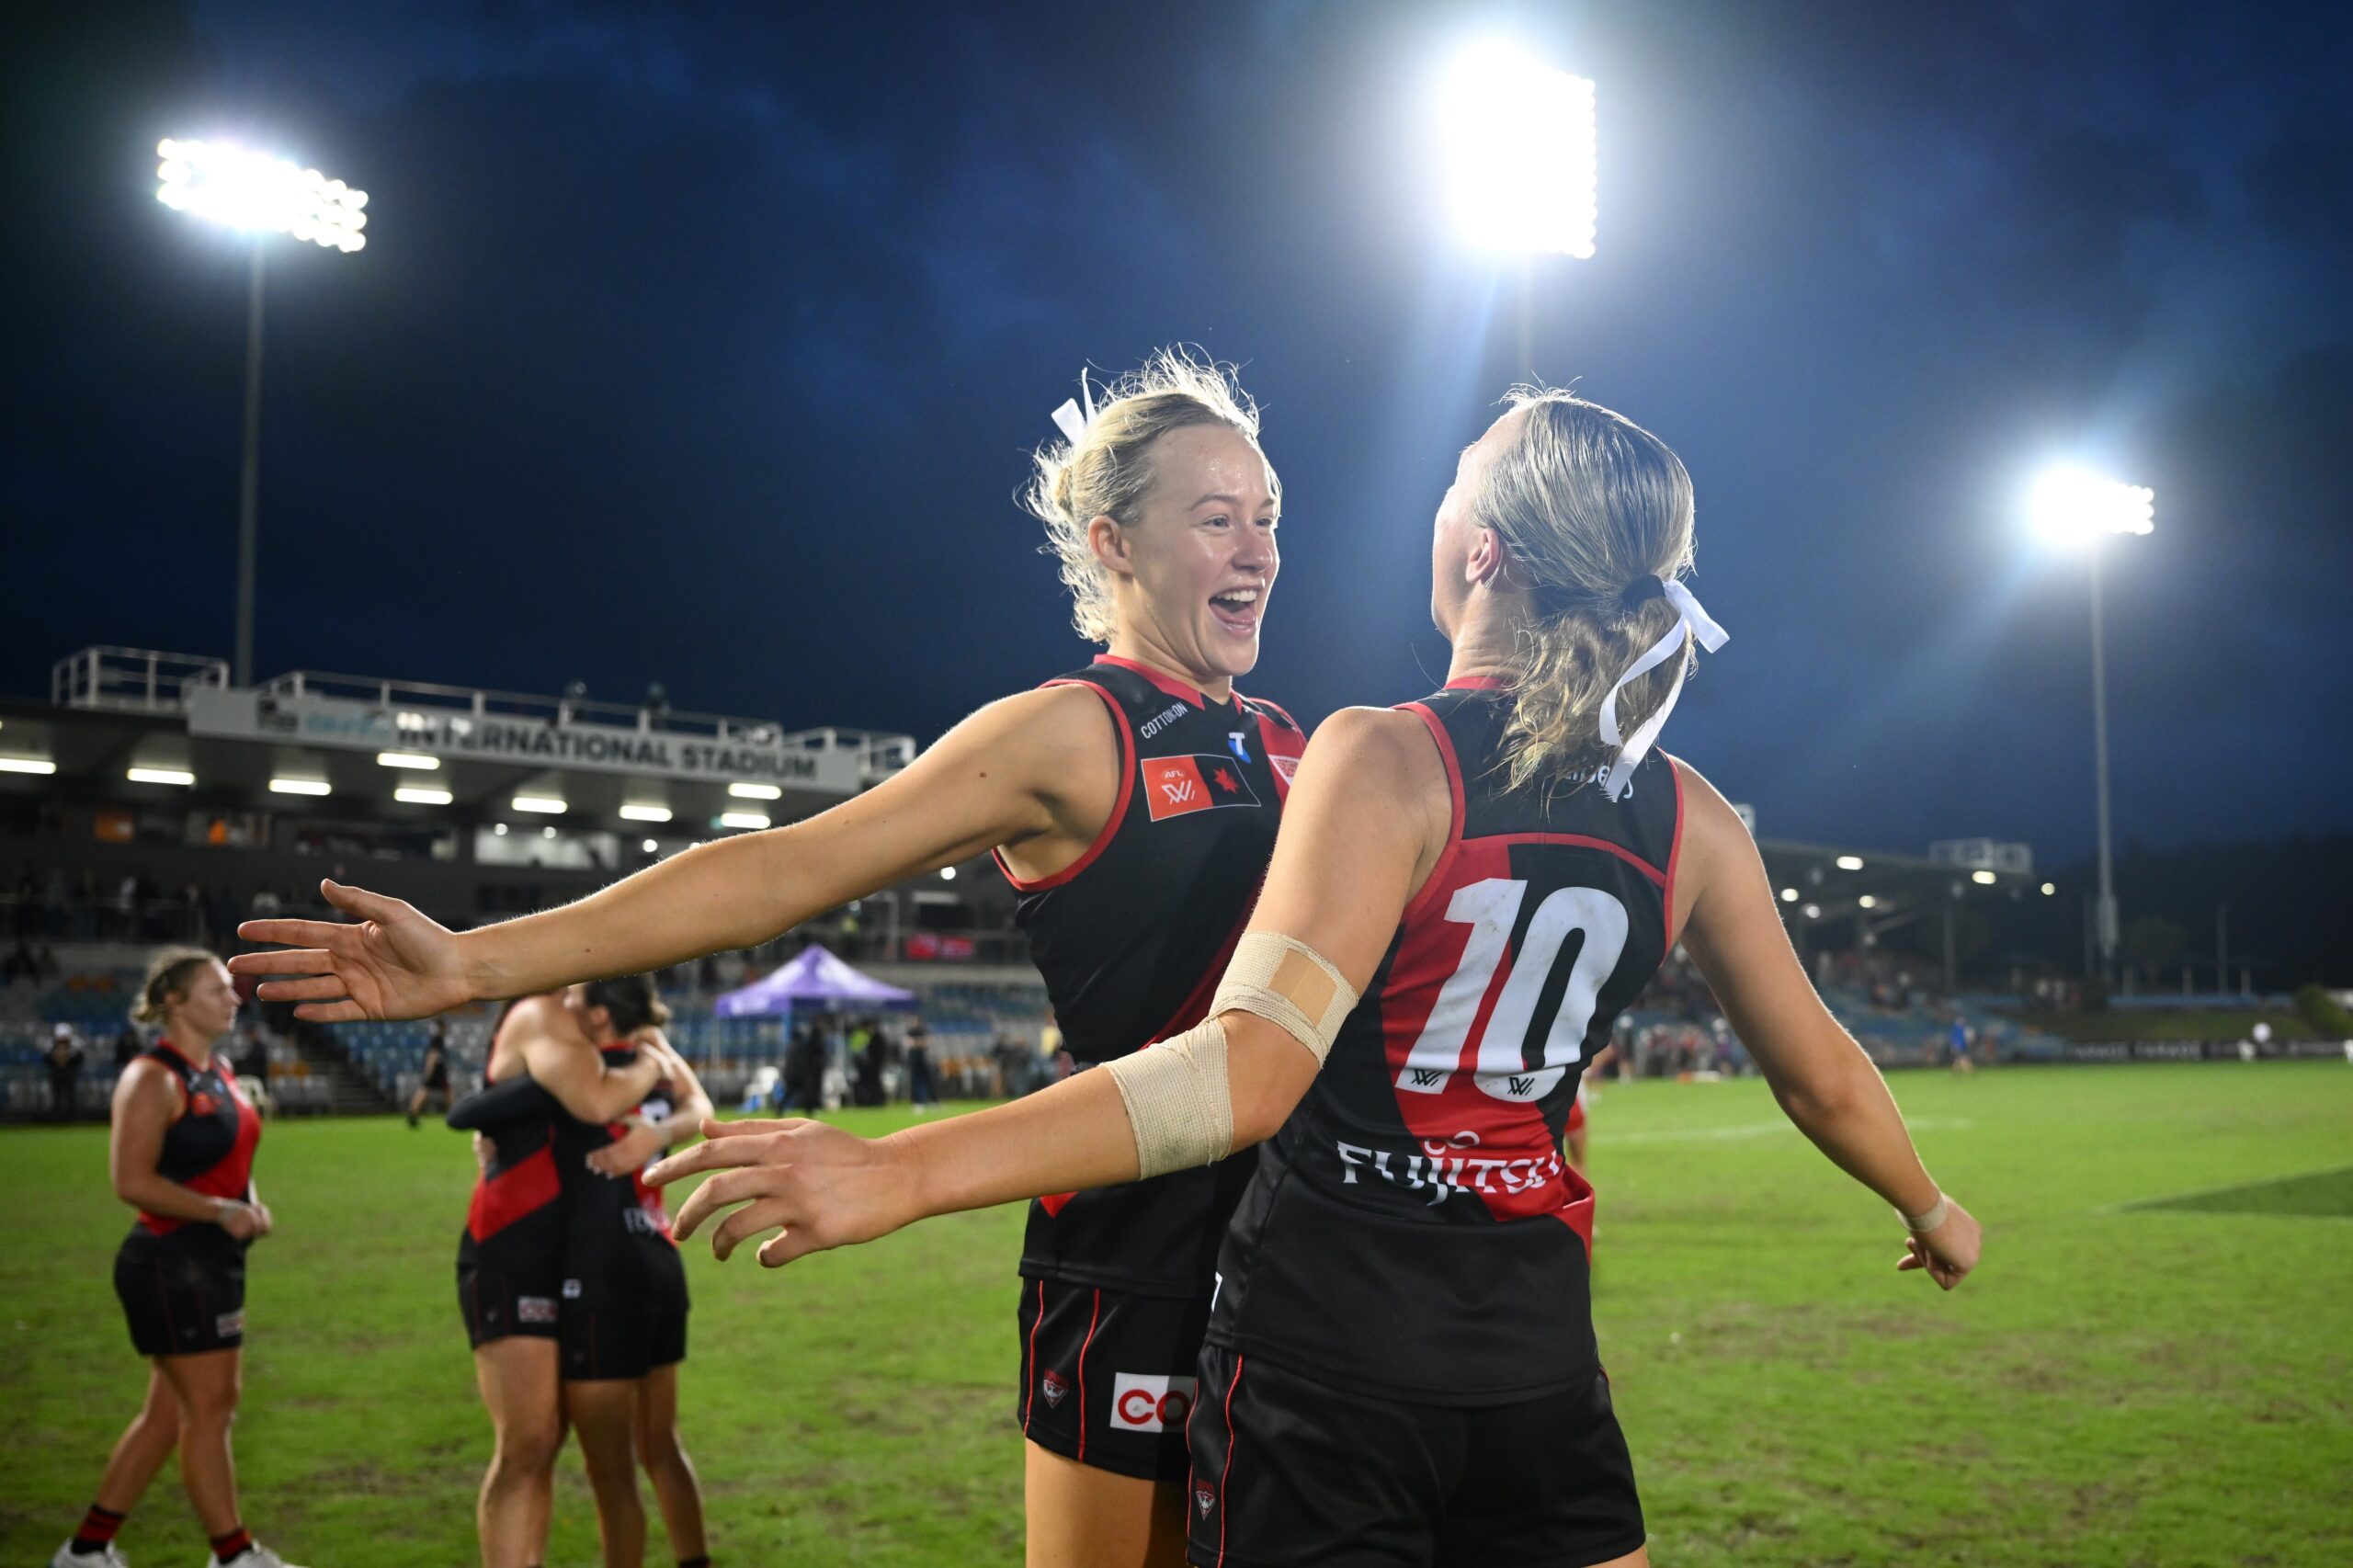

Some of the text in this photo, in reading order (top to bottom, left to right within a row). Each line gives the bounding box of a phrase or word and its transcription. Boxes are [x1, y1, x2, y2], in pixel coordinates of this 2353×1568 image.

[397, 715, 670, 768] INTERNATIONAL
[680, 745, 816, 778] STADIUM
[1395, 878, 1629, 1103] 10
[1336, 1140, 1561, 1207] FUJITSU
